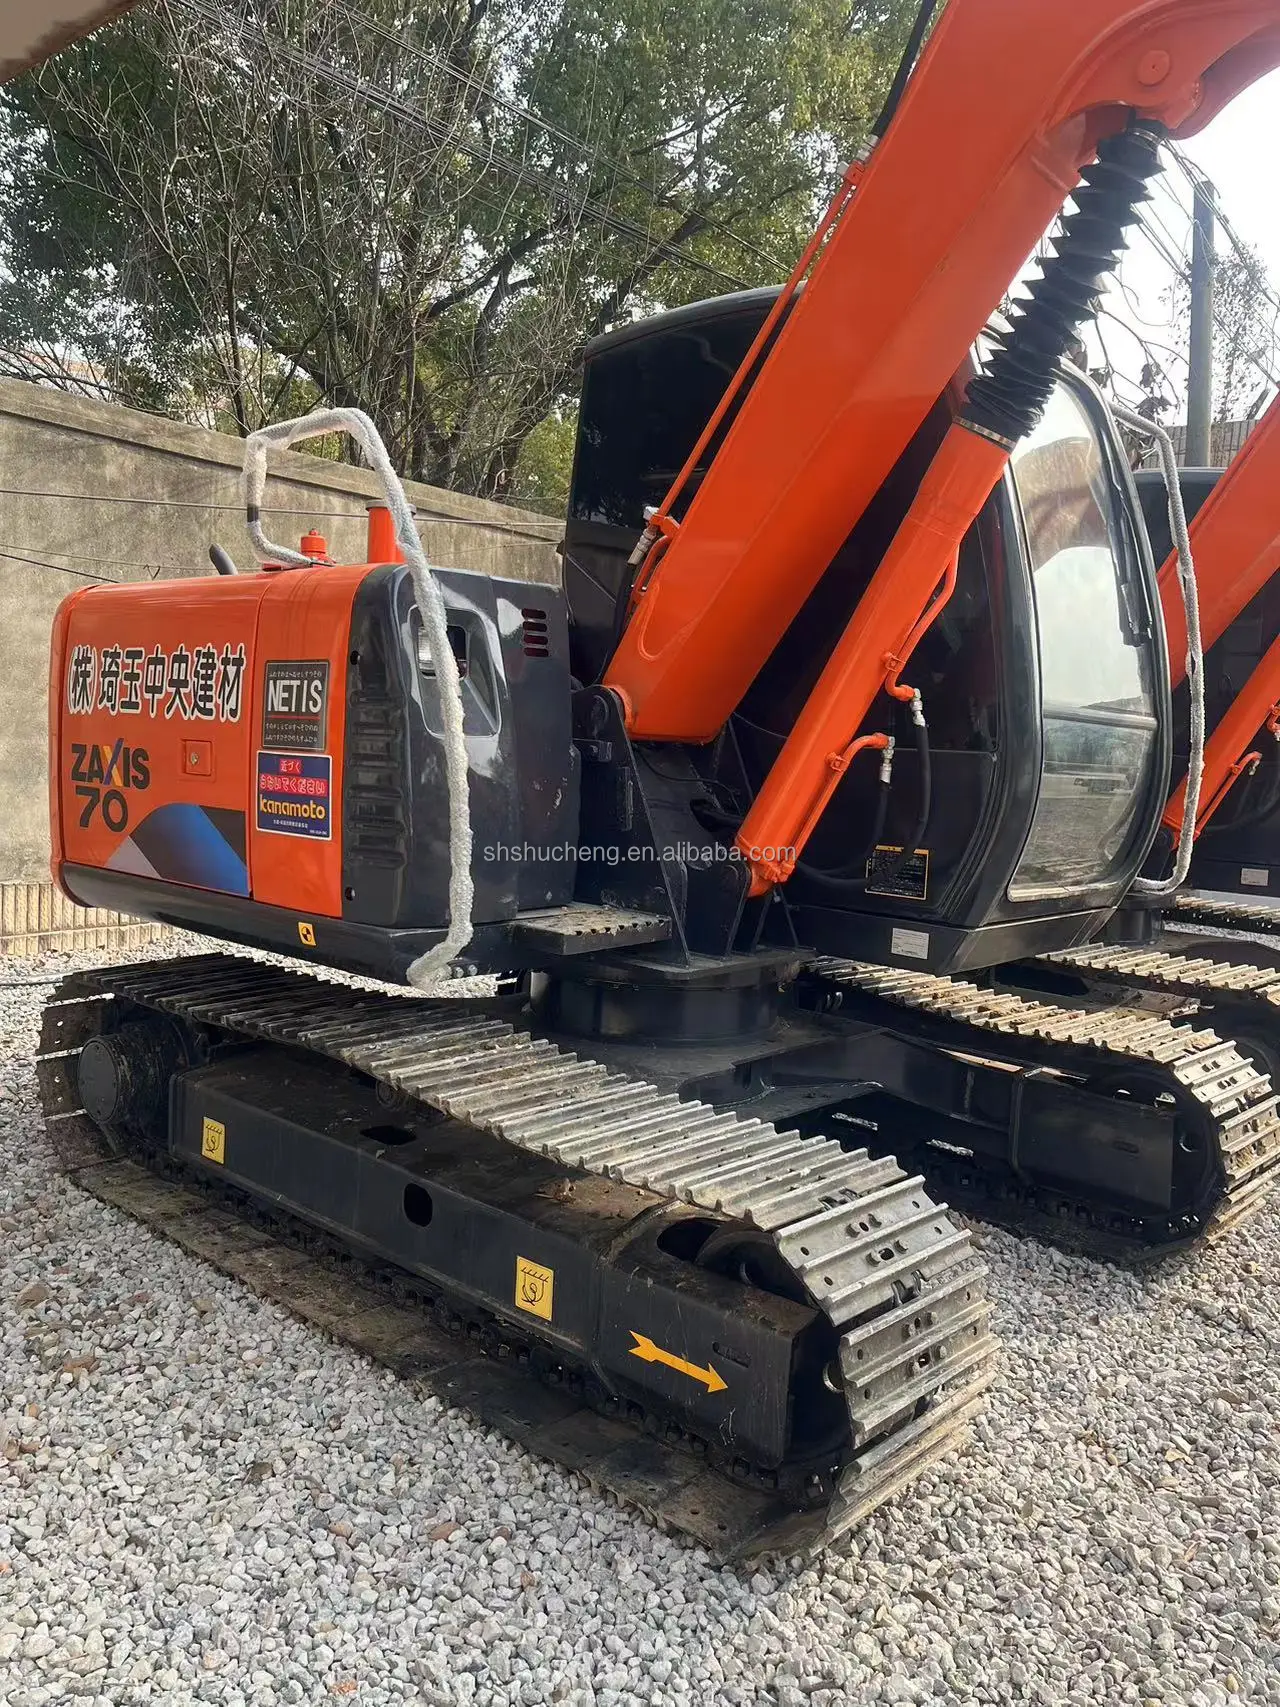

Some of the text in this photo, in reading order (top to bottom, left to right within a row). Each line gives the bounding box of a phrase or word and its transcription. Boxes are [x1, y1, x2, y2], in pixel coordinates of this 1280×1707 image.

[267, 679, 323, 714] NETIS
[71, 738, 151, 790] ZAXIS
[75, 786, 129, 832] 70
[259, 794, 326, 820] kanamoto
